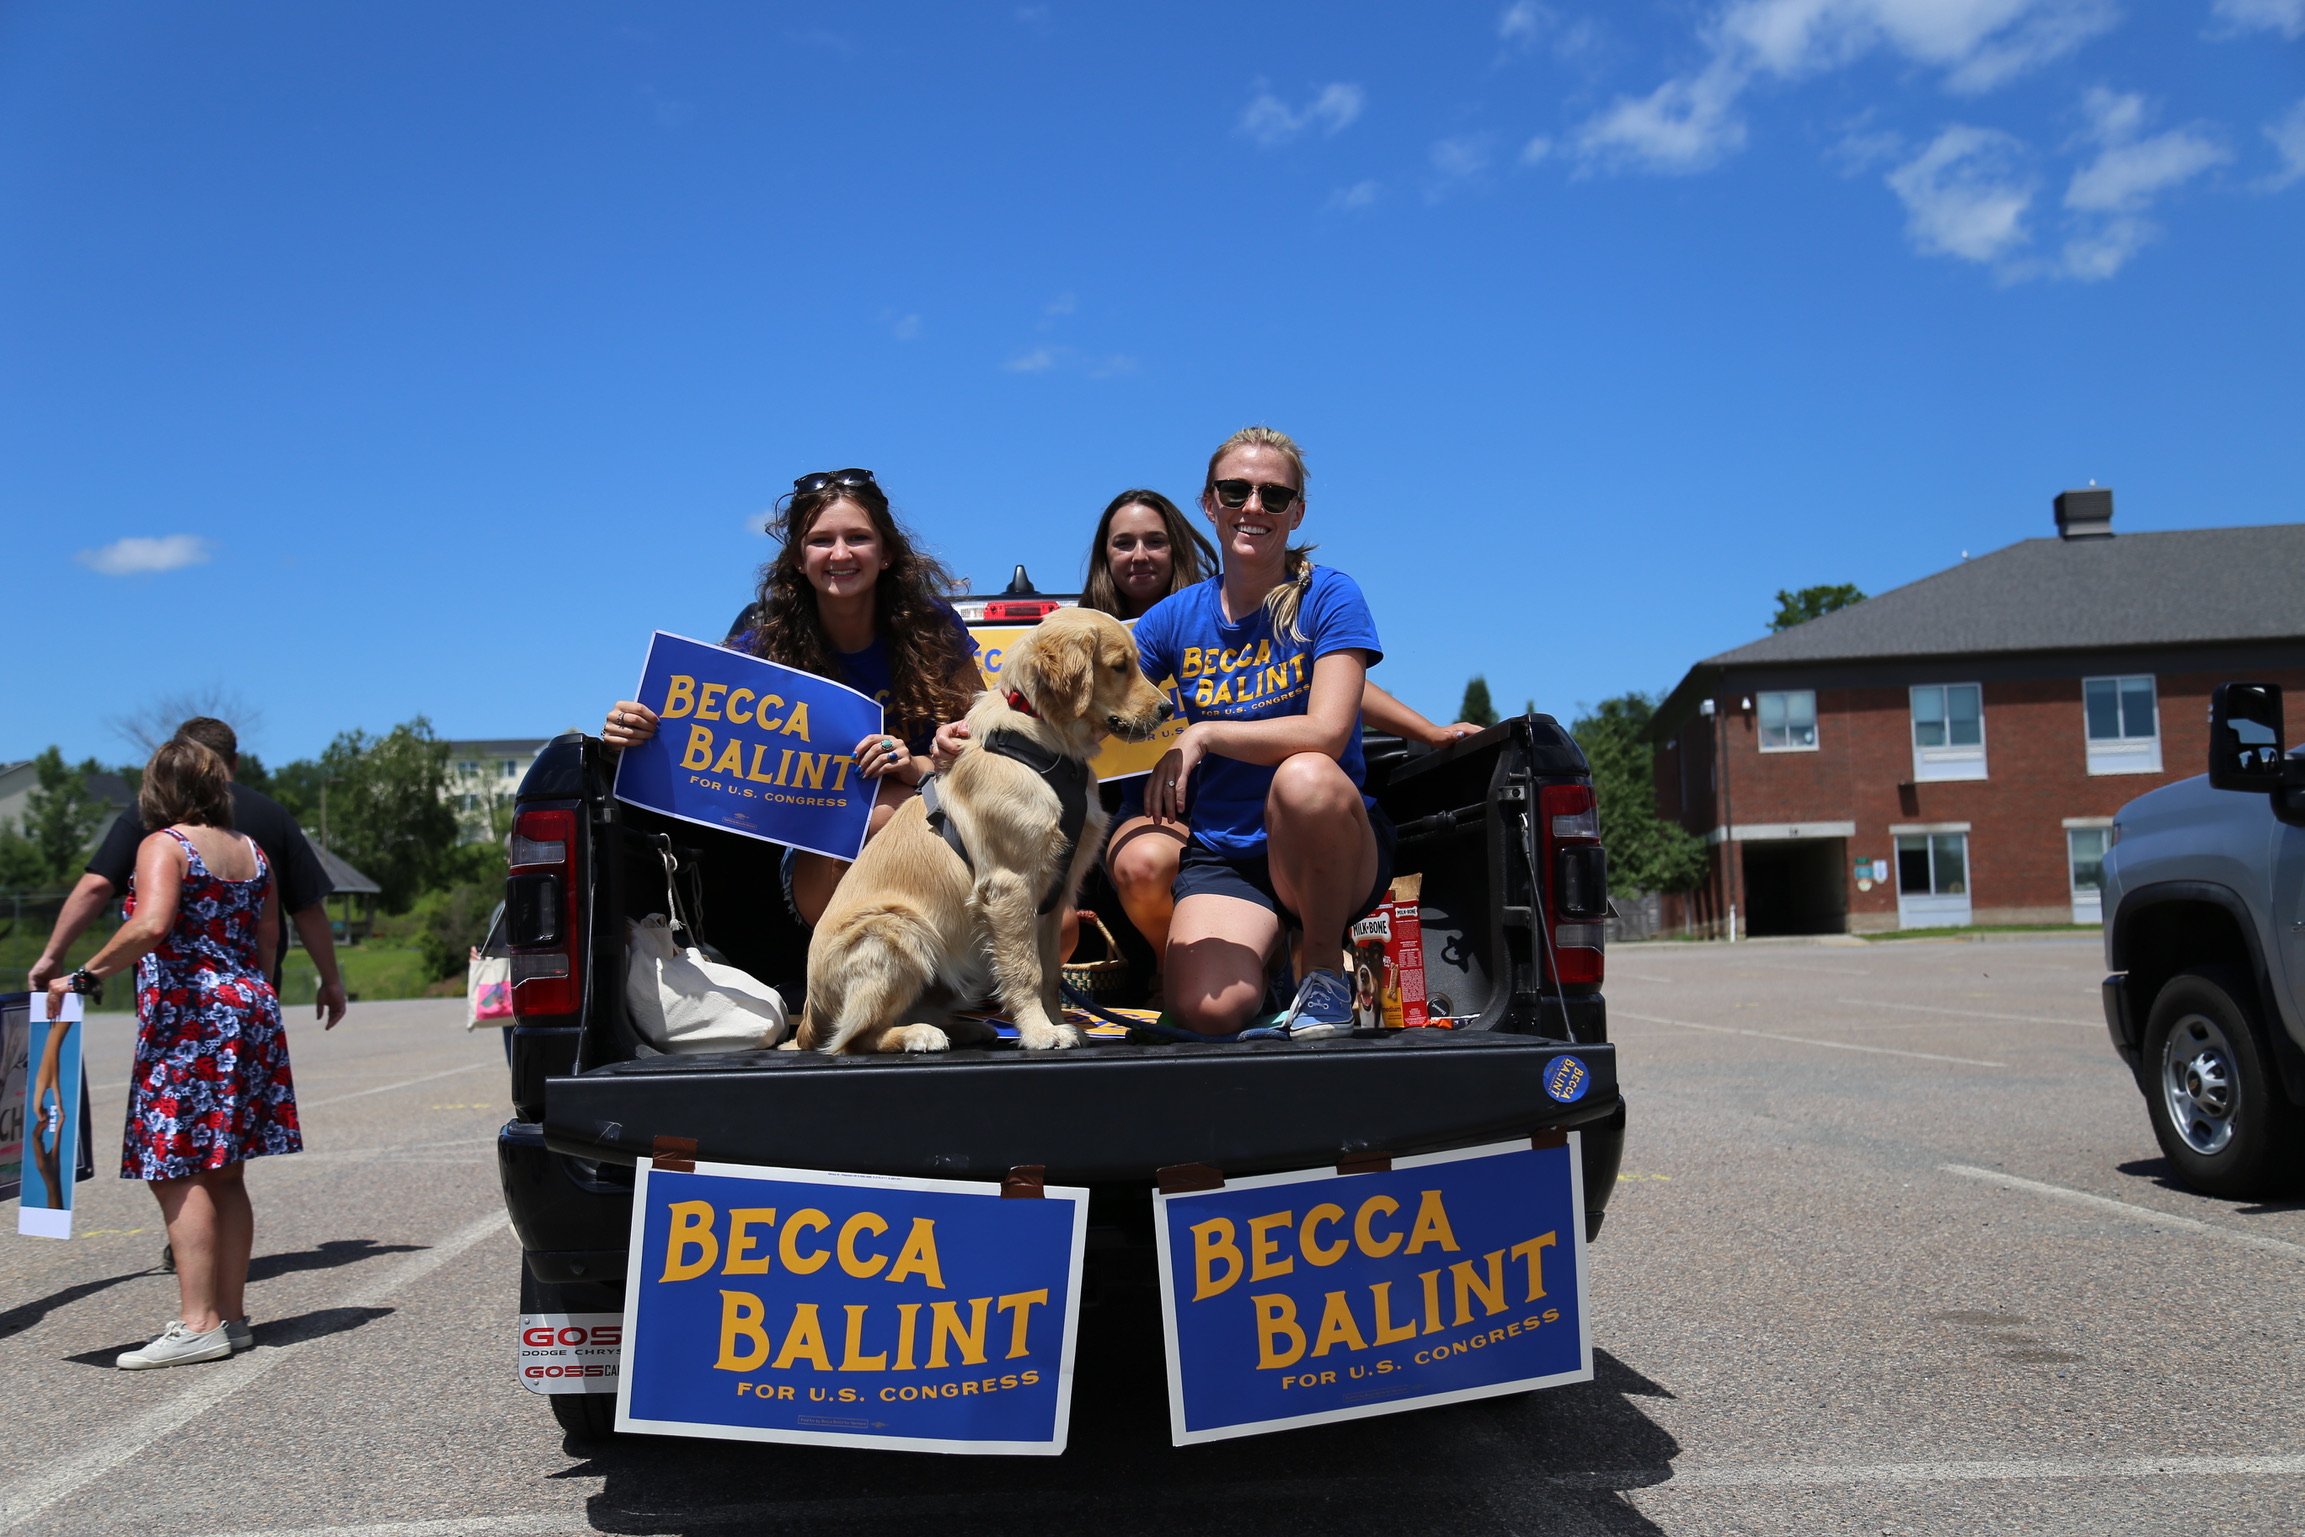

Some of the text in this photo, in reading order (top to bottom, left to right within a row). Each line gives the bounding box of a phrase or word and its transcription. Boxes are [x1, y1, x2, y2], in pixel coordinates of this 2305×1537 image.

[1181, 638, 1272, 679] BECCA
[1195, 652, 1307, 708] BALINT
[1201, 683, 1313, 718] FOR U.S. CONGRESS
[660, 674, 811, 743] BECCA
[679, 723, 862, 792] BALINT
[689, 775, 848, 808] FOR U.S. CONGRESS
[1551, 1058, 1576, 1098] BALINT
[1561, 1066, 1584, 1099] BECCA
[658, 1200, 946, 1290] BECCA
[1189, 1189, 1461, 1303] BECCA
[1250, 1230, 1558, 1371] BALINT
[523, 1327, 622, 1347] GOS
[712, 1288, 1049, 1373] BALINT
[1282, 1307, 1561, 1391] FOR U.S. CONGRESS
[522, 1349, 567, 1357] DODGE
[525, 1364, 621, 1379] GOSSCA
[737, 1369, 1041, 1403] FOR U.S. CONGRESS
